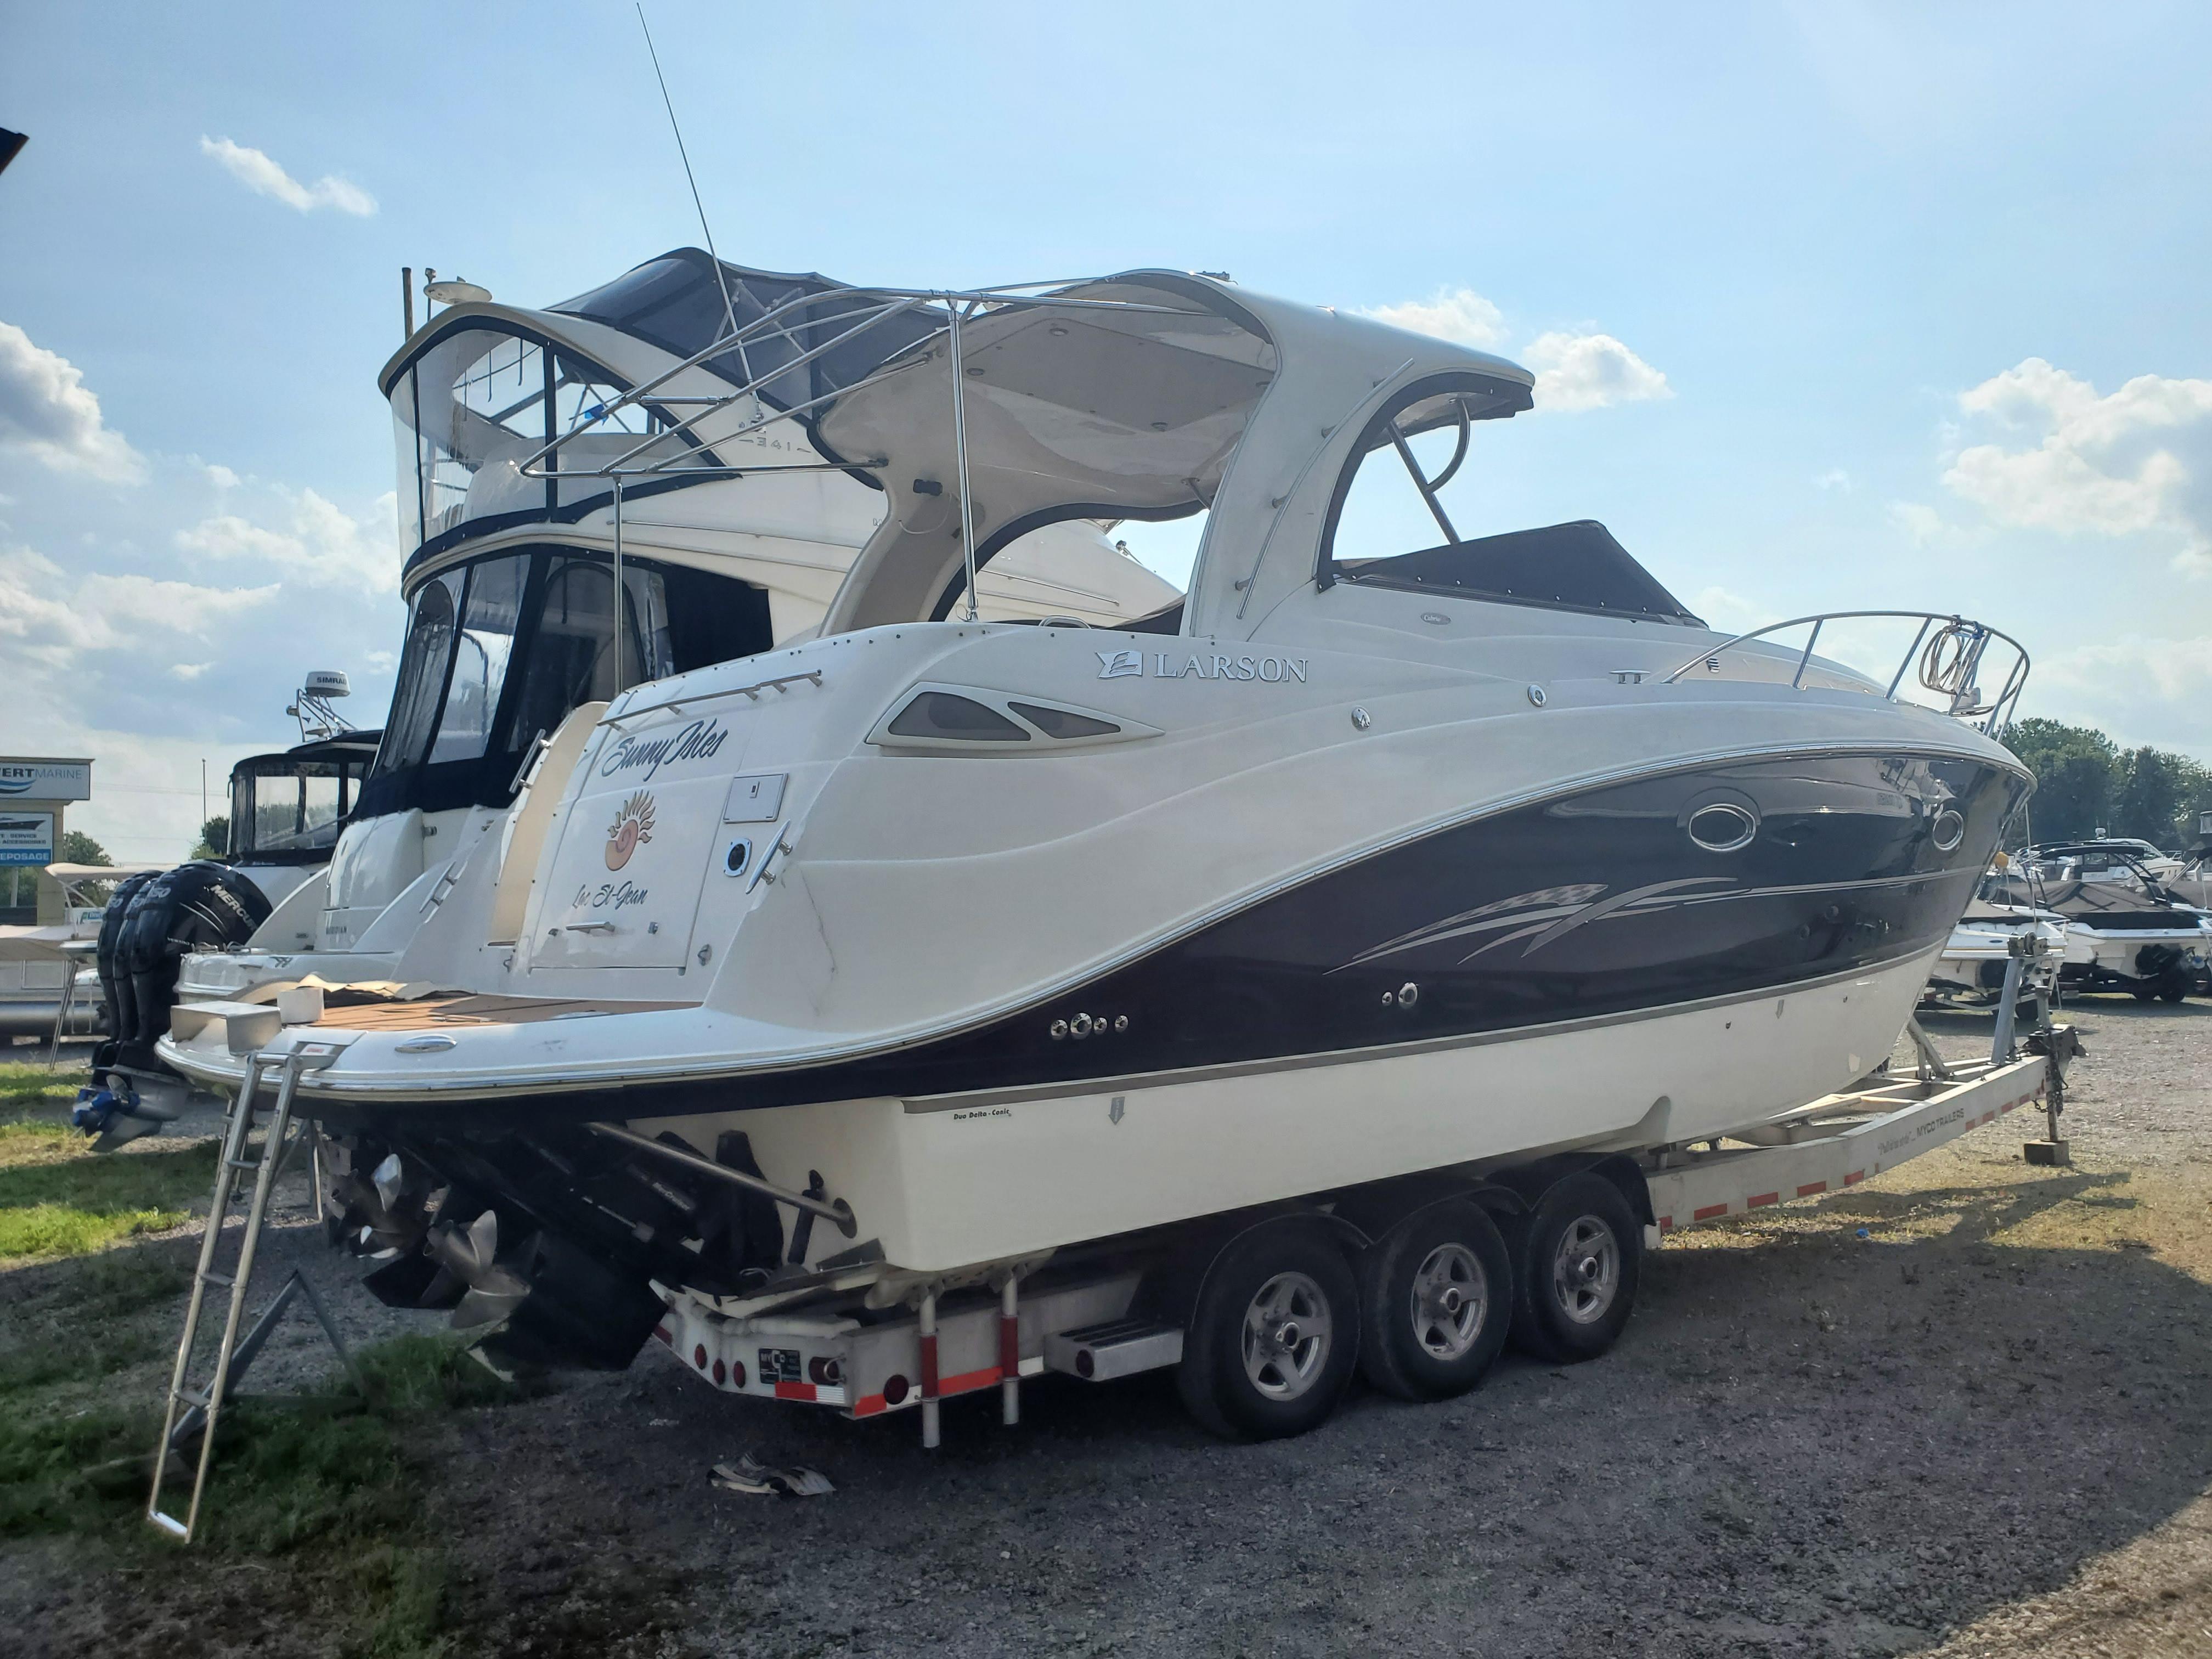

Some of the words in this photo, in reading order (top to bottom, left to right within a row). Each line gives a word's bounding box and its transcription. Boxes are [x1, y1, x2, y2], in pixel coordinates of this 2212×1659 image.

[317, 676, 347, 685] SIMRAD
[1154, 653, 1308, 682] LARSON
[602, 736, 675, 782] Sunny
[664, 718, 728, 765] Isles
[210, 884, 258, 932] MERCUR
[1936, 1108, 1964, 1128] TRAILERS
